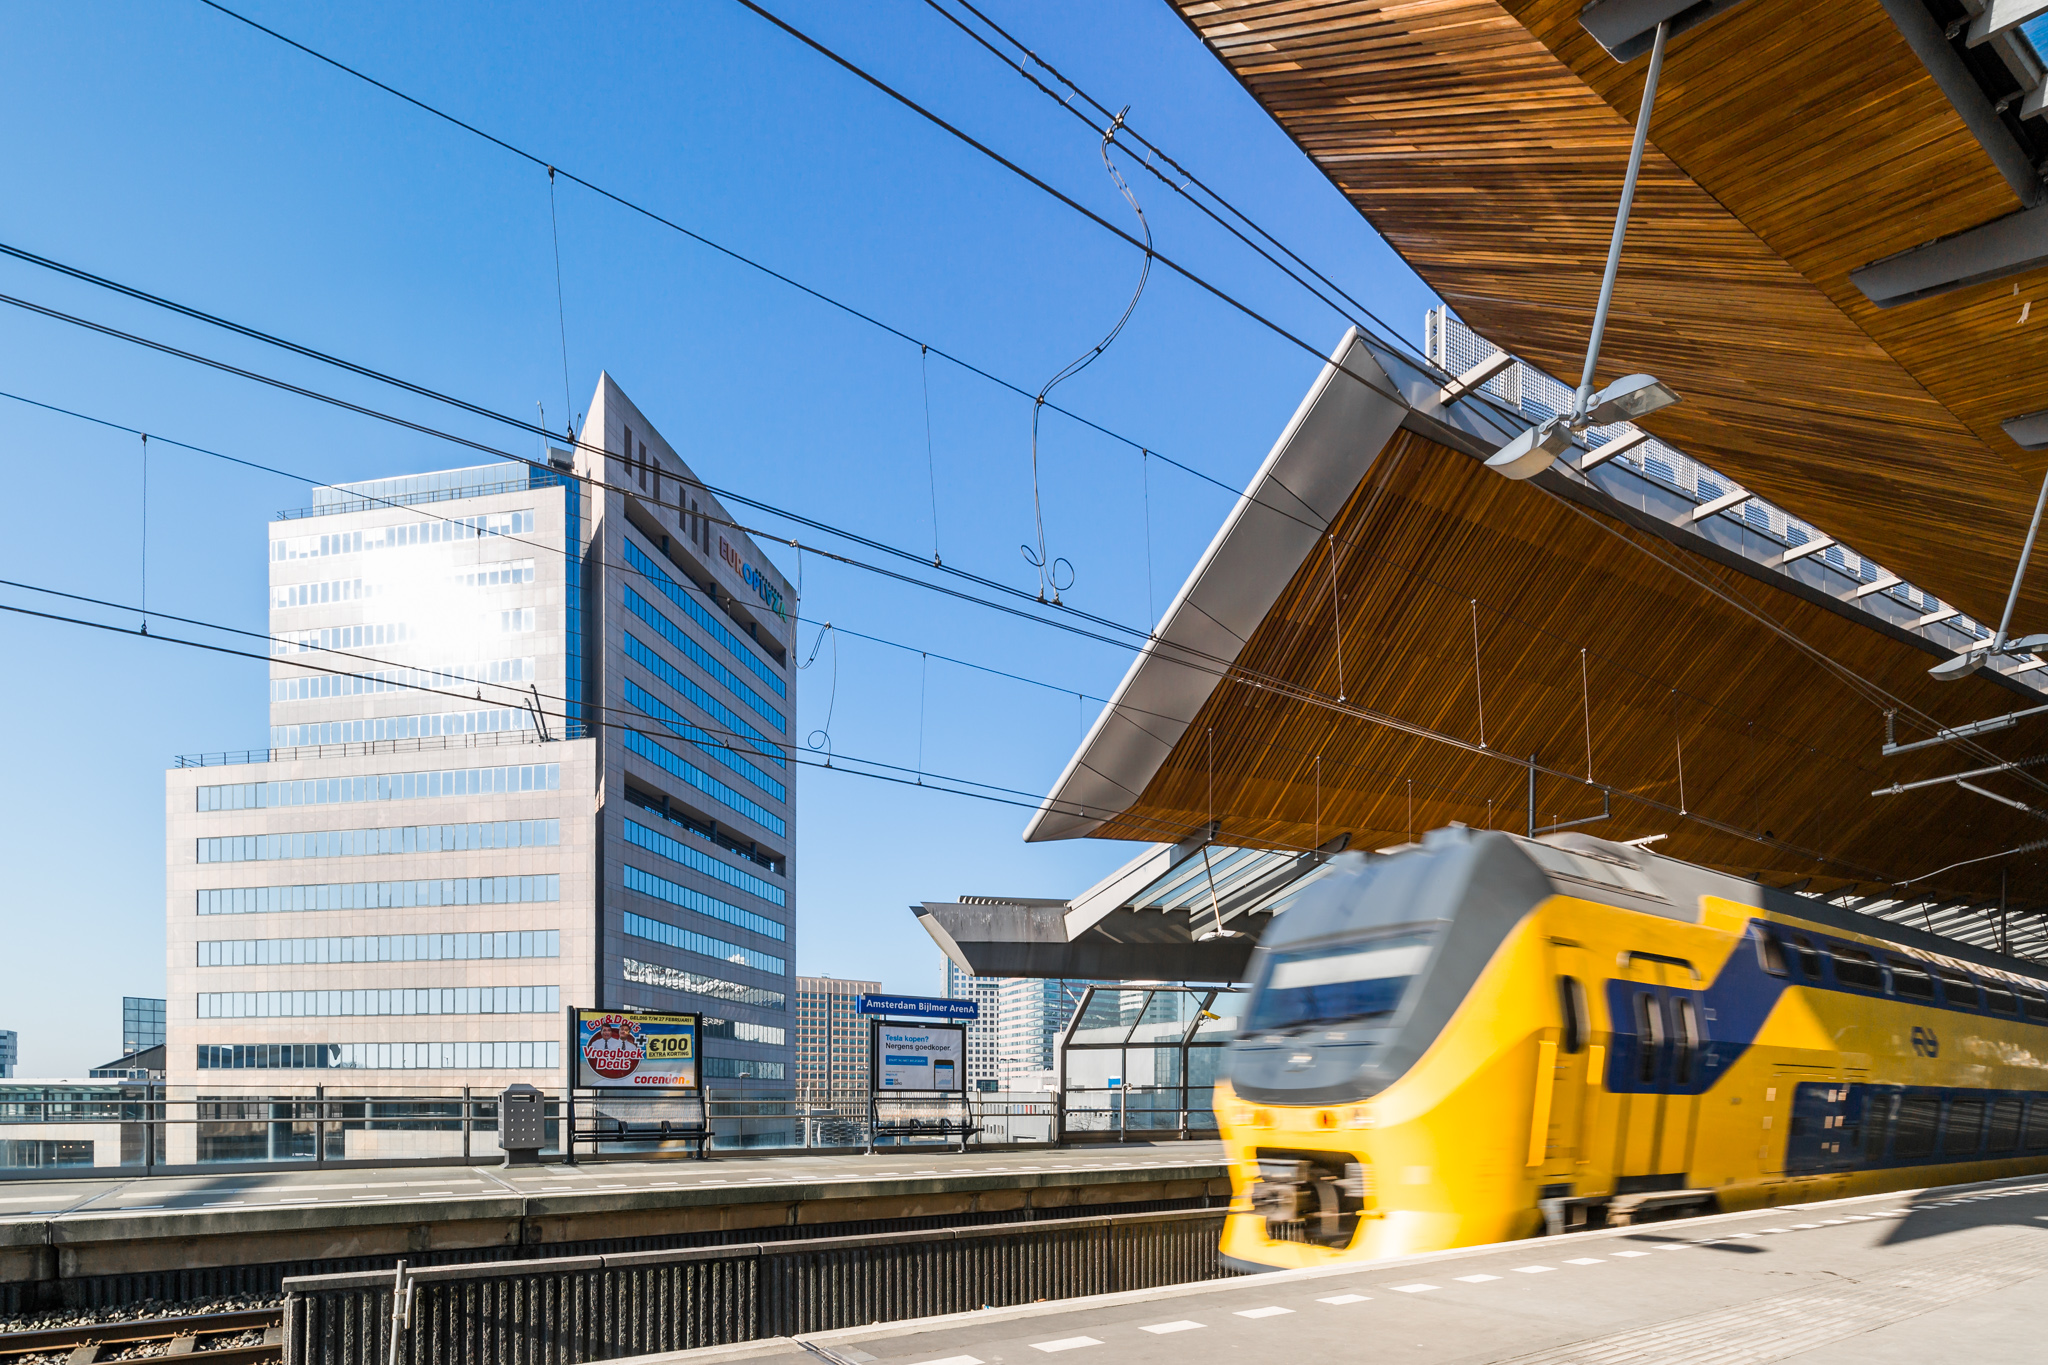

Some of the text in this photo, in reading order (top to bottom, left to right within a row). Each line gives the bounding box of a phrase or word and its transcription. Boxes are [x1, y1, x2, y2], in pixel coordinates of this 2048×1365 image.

[719, 535, 787, 624] EUROPLAZA
[866, 999, 975, 1014] Amsterdam Bijlmer ArenA
[885, 1034, 929, 1043] Tesla kopen?
[649, 1038, 688, 1052] €100
[885, 1042, 952, 1052] Nergens goedkoper.
[583, 1047, 644, 1059] Vroegboek
[597, 1058, 630, 1069] Deals
